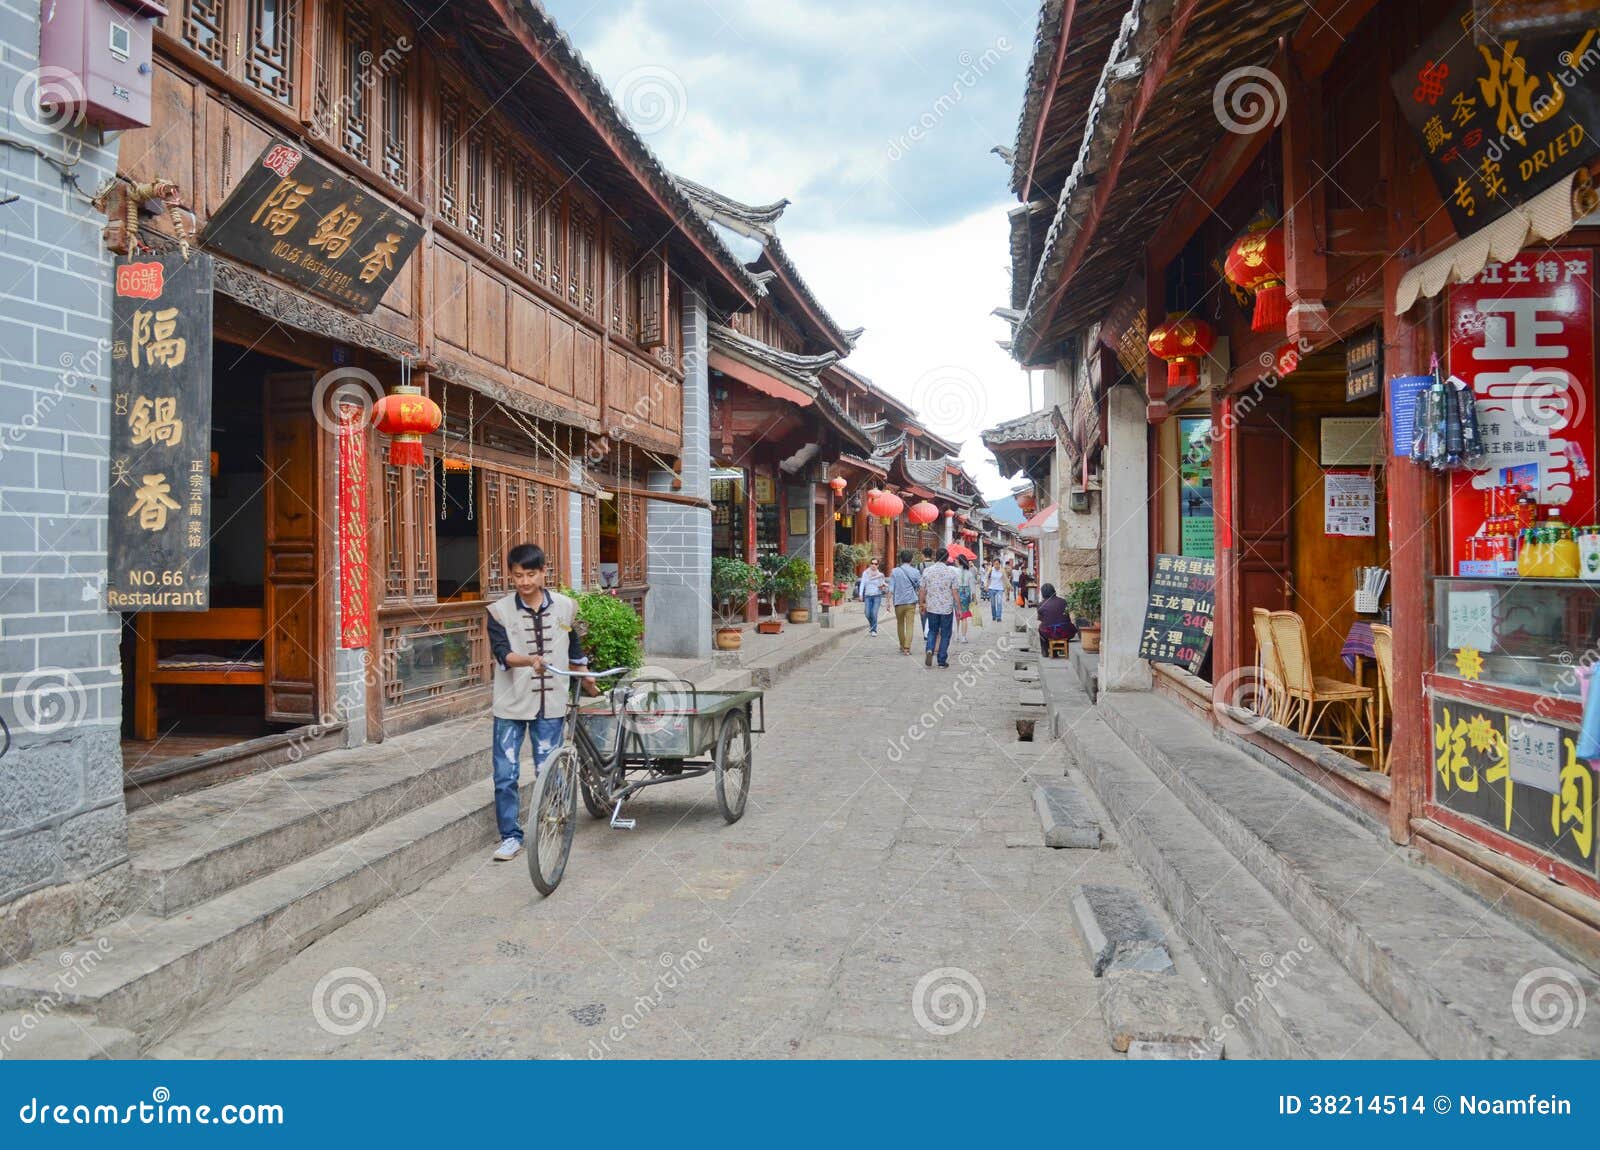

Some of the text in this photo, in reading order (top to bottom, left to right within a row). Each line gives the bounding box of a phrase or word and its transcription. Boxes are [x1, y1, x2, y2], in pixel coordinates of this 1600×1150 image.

[1519, 123, 1584, 181] DRIED
[251, 176, 402, 284] 隔鍋香
[120, 268, 159, 293] 66號
[271, 240, 353, 288] NO.66 Restaurant
[1455, 260, 1588, 284] 江土特产
[127, 307, 187, 531] 隔鍋香
[129, 570, 183, 586] NO.66
[108, 590, 204, 606] Restaurant
